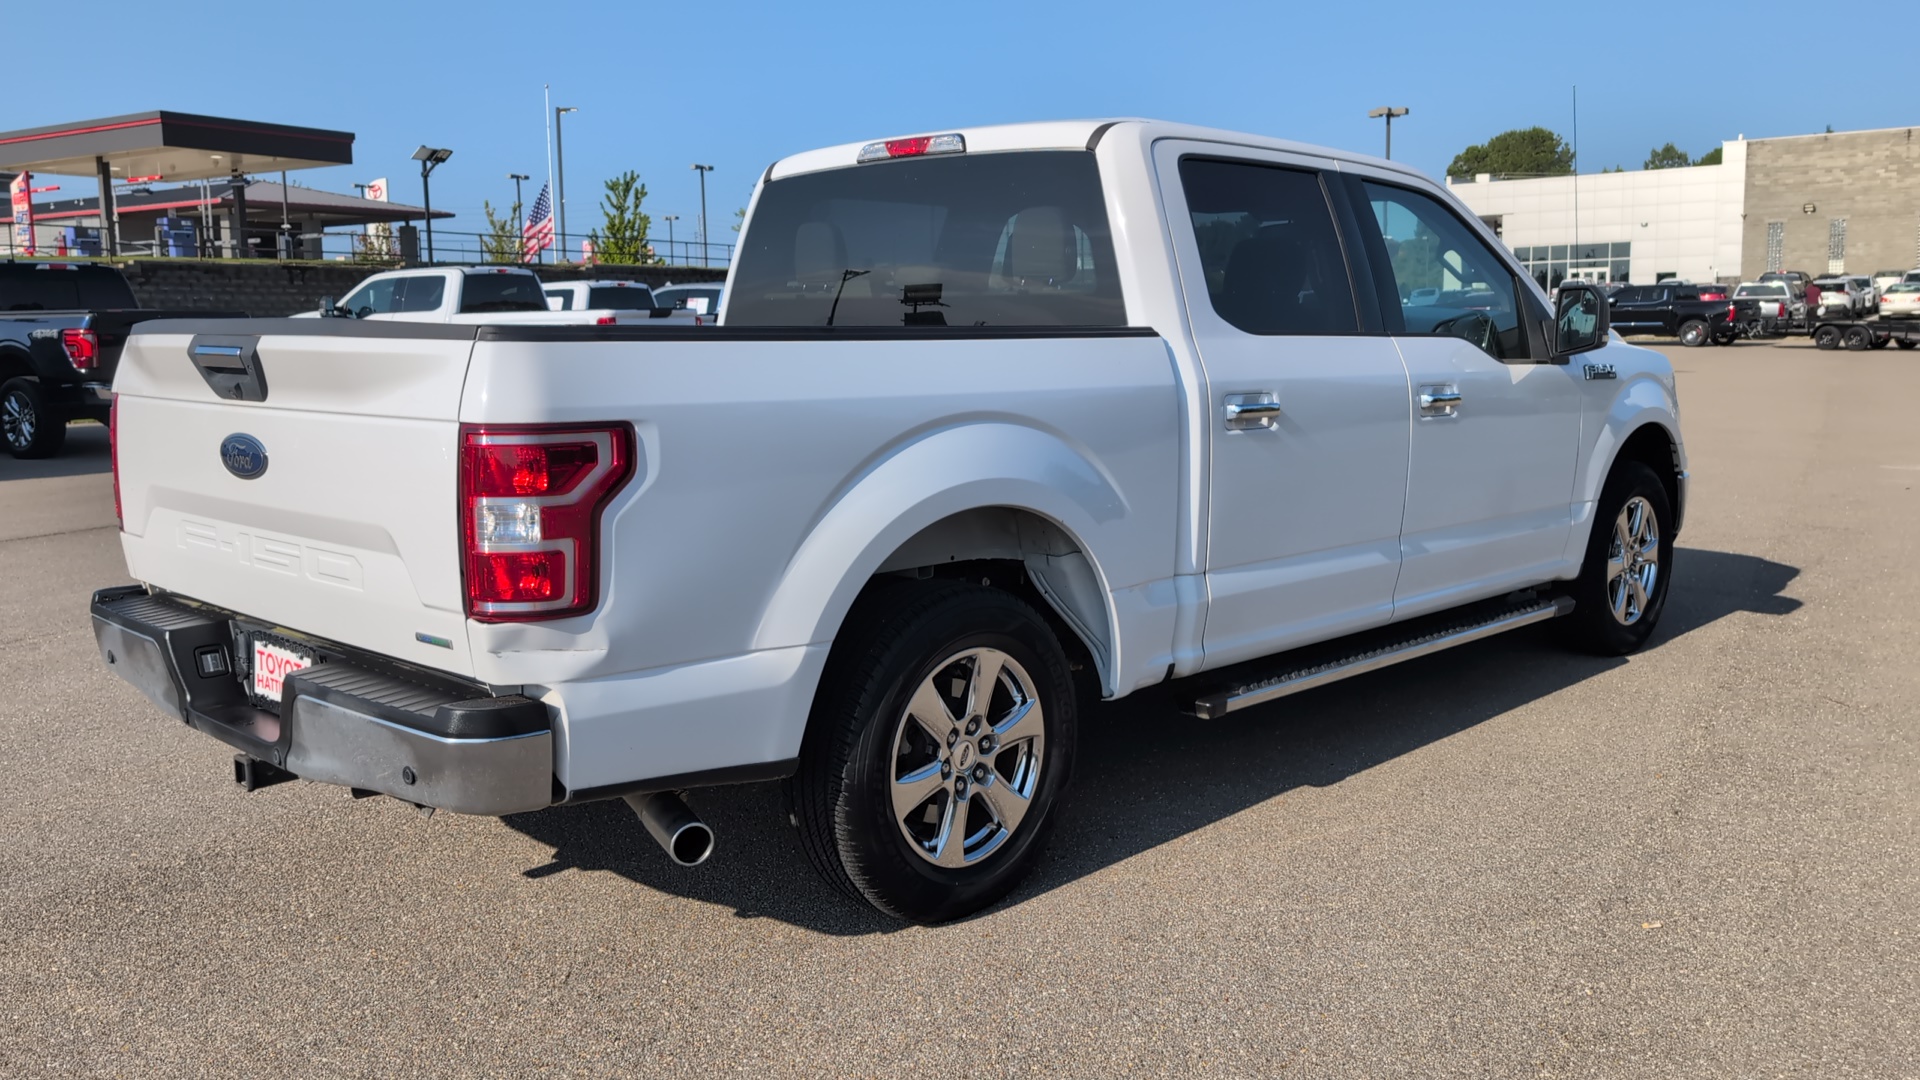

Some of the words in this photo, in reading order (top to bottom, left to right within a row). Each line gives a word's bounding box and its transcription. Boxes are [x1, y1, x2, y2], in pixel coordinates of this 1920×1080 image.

[226, 442, 254, 470] Ford
[177, 519, 364, 592] F-150
[257, 649, 308, 678] TOYO
[257, 673, 284, 695] HATTI
